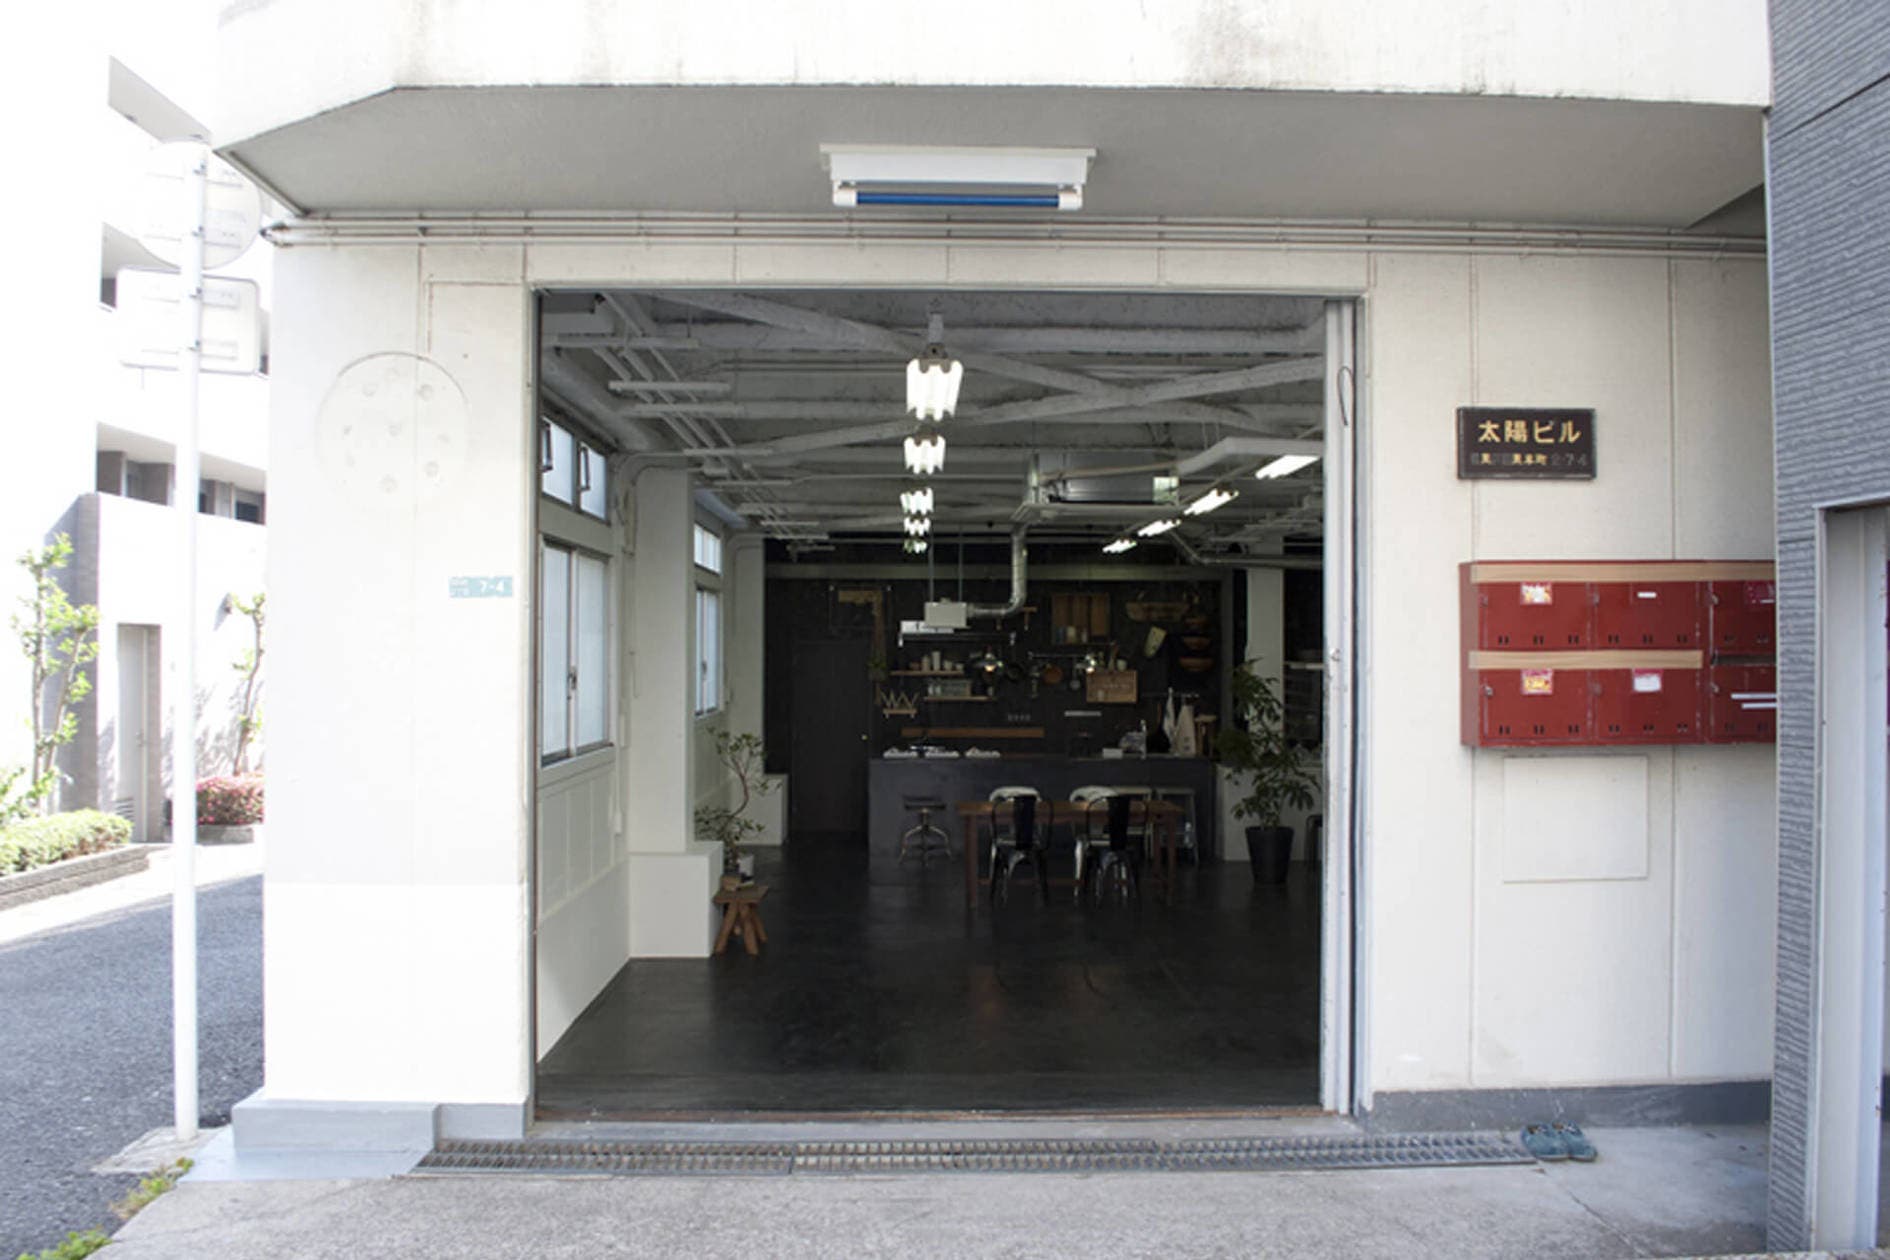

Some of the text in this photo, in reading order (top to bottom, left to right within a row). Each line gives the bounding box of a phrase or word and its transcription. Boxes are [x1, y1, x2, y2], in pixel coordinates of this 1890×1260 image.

[1477, 419, 1582, 443] 太陽ビル
[480, 580, 504, 592] 7-4
